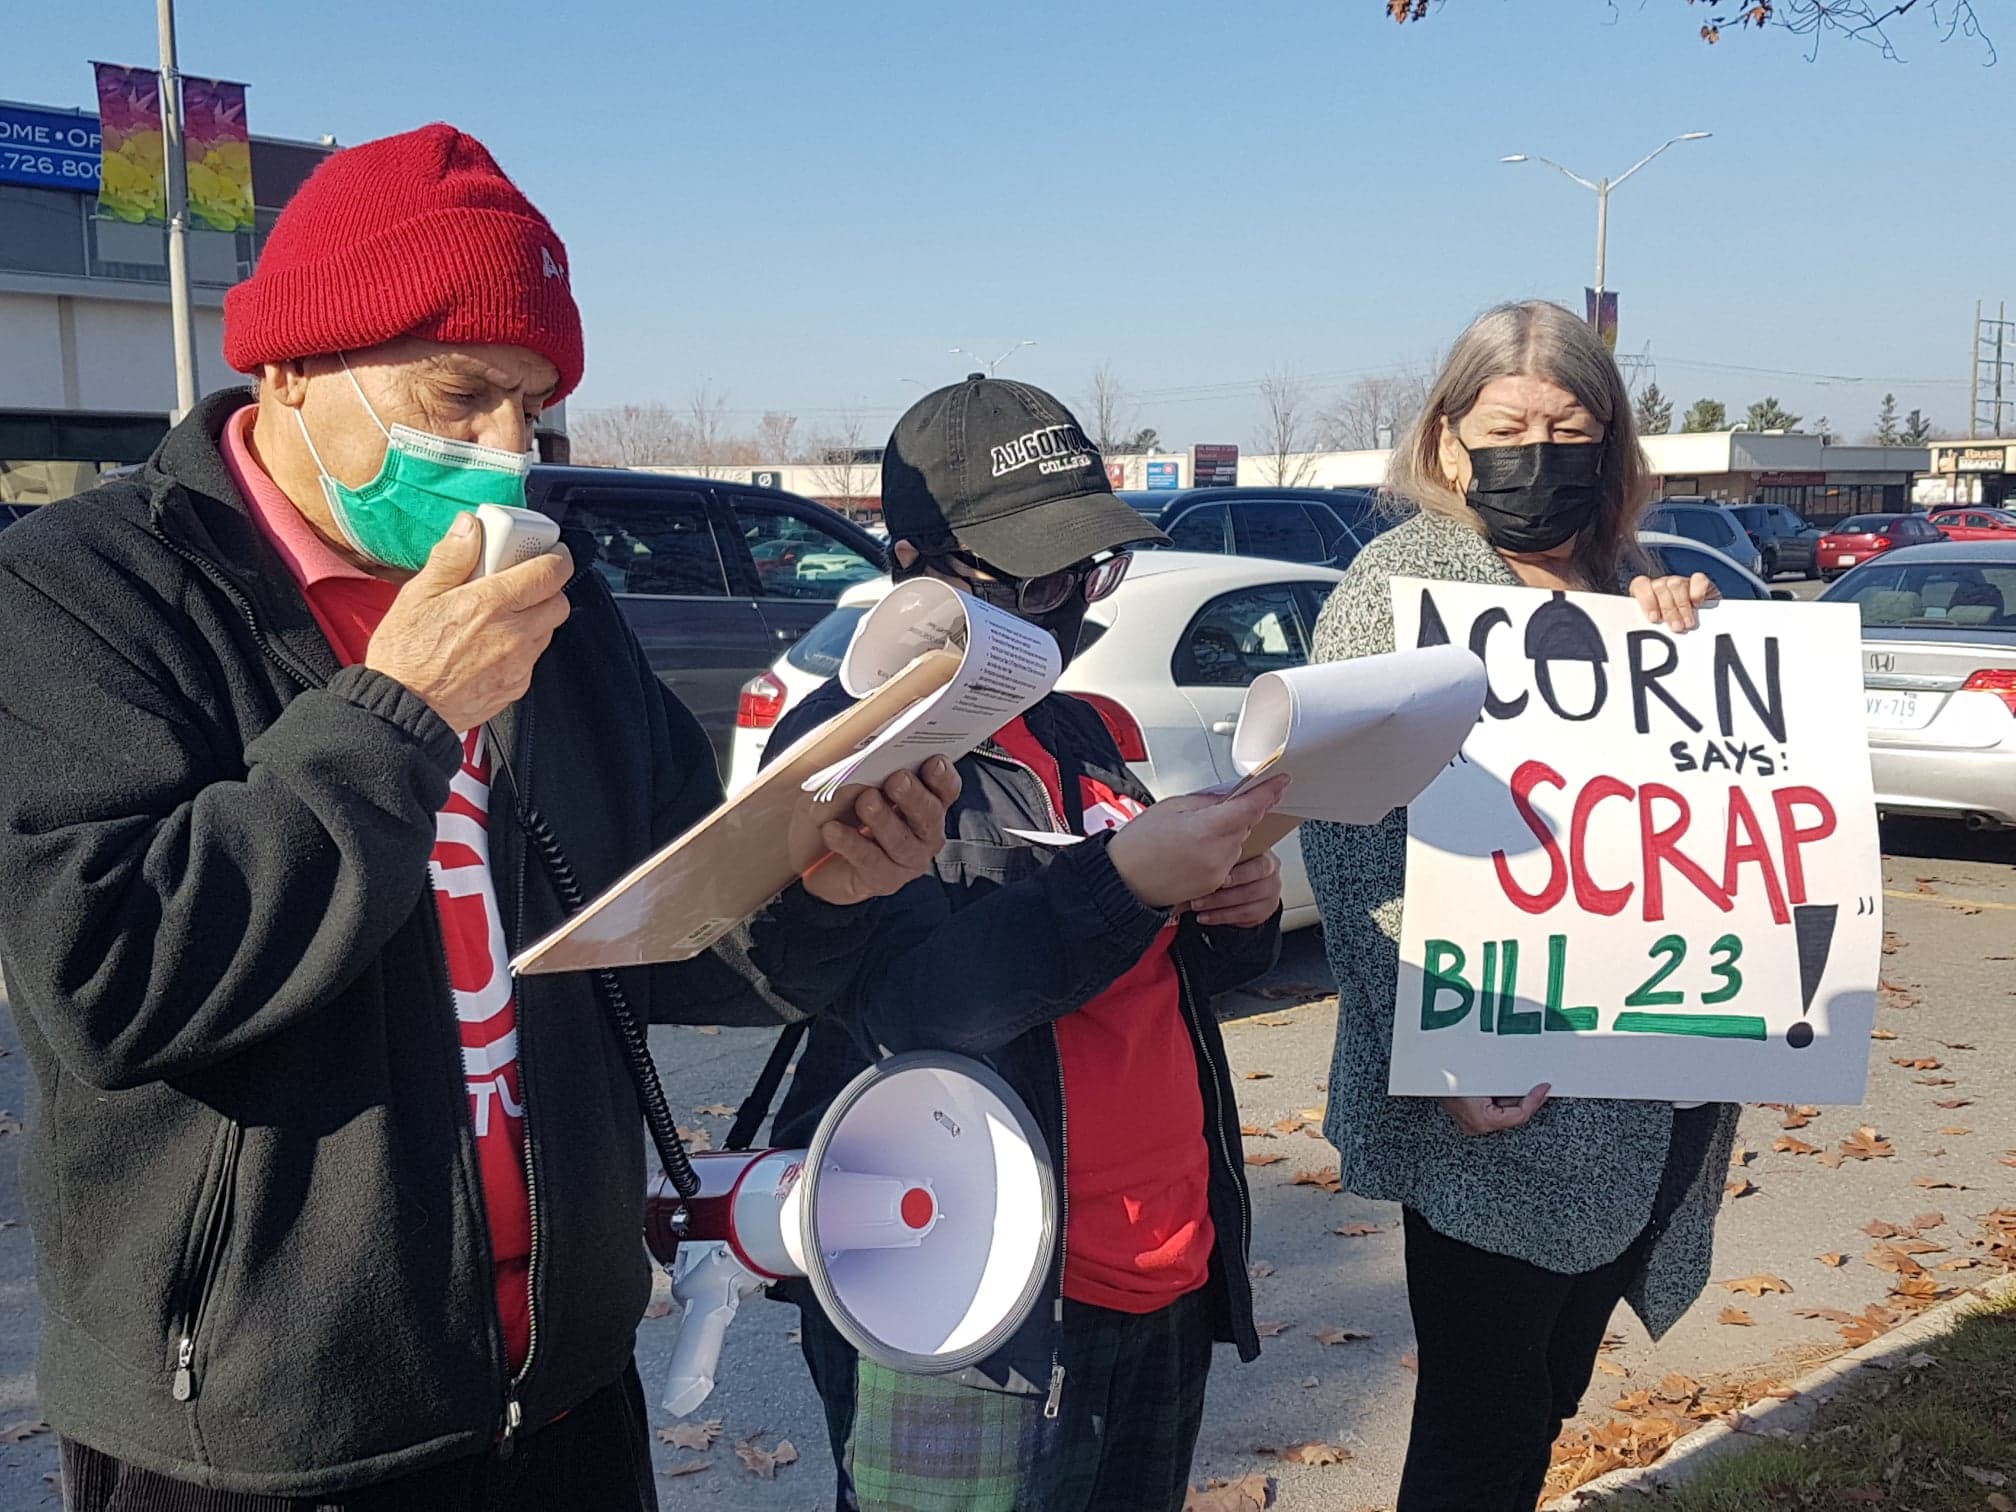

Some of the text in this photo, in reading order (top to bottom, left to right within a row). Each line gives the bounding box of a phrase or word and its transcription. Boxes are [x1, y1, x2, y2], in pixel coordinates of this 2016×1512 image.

[1669, 740, 1789, 776] SAYS:
[1491, 760, 1837, 925] SCRAP
[1420, 933, 1599, 1036] BILL
